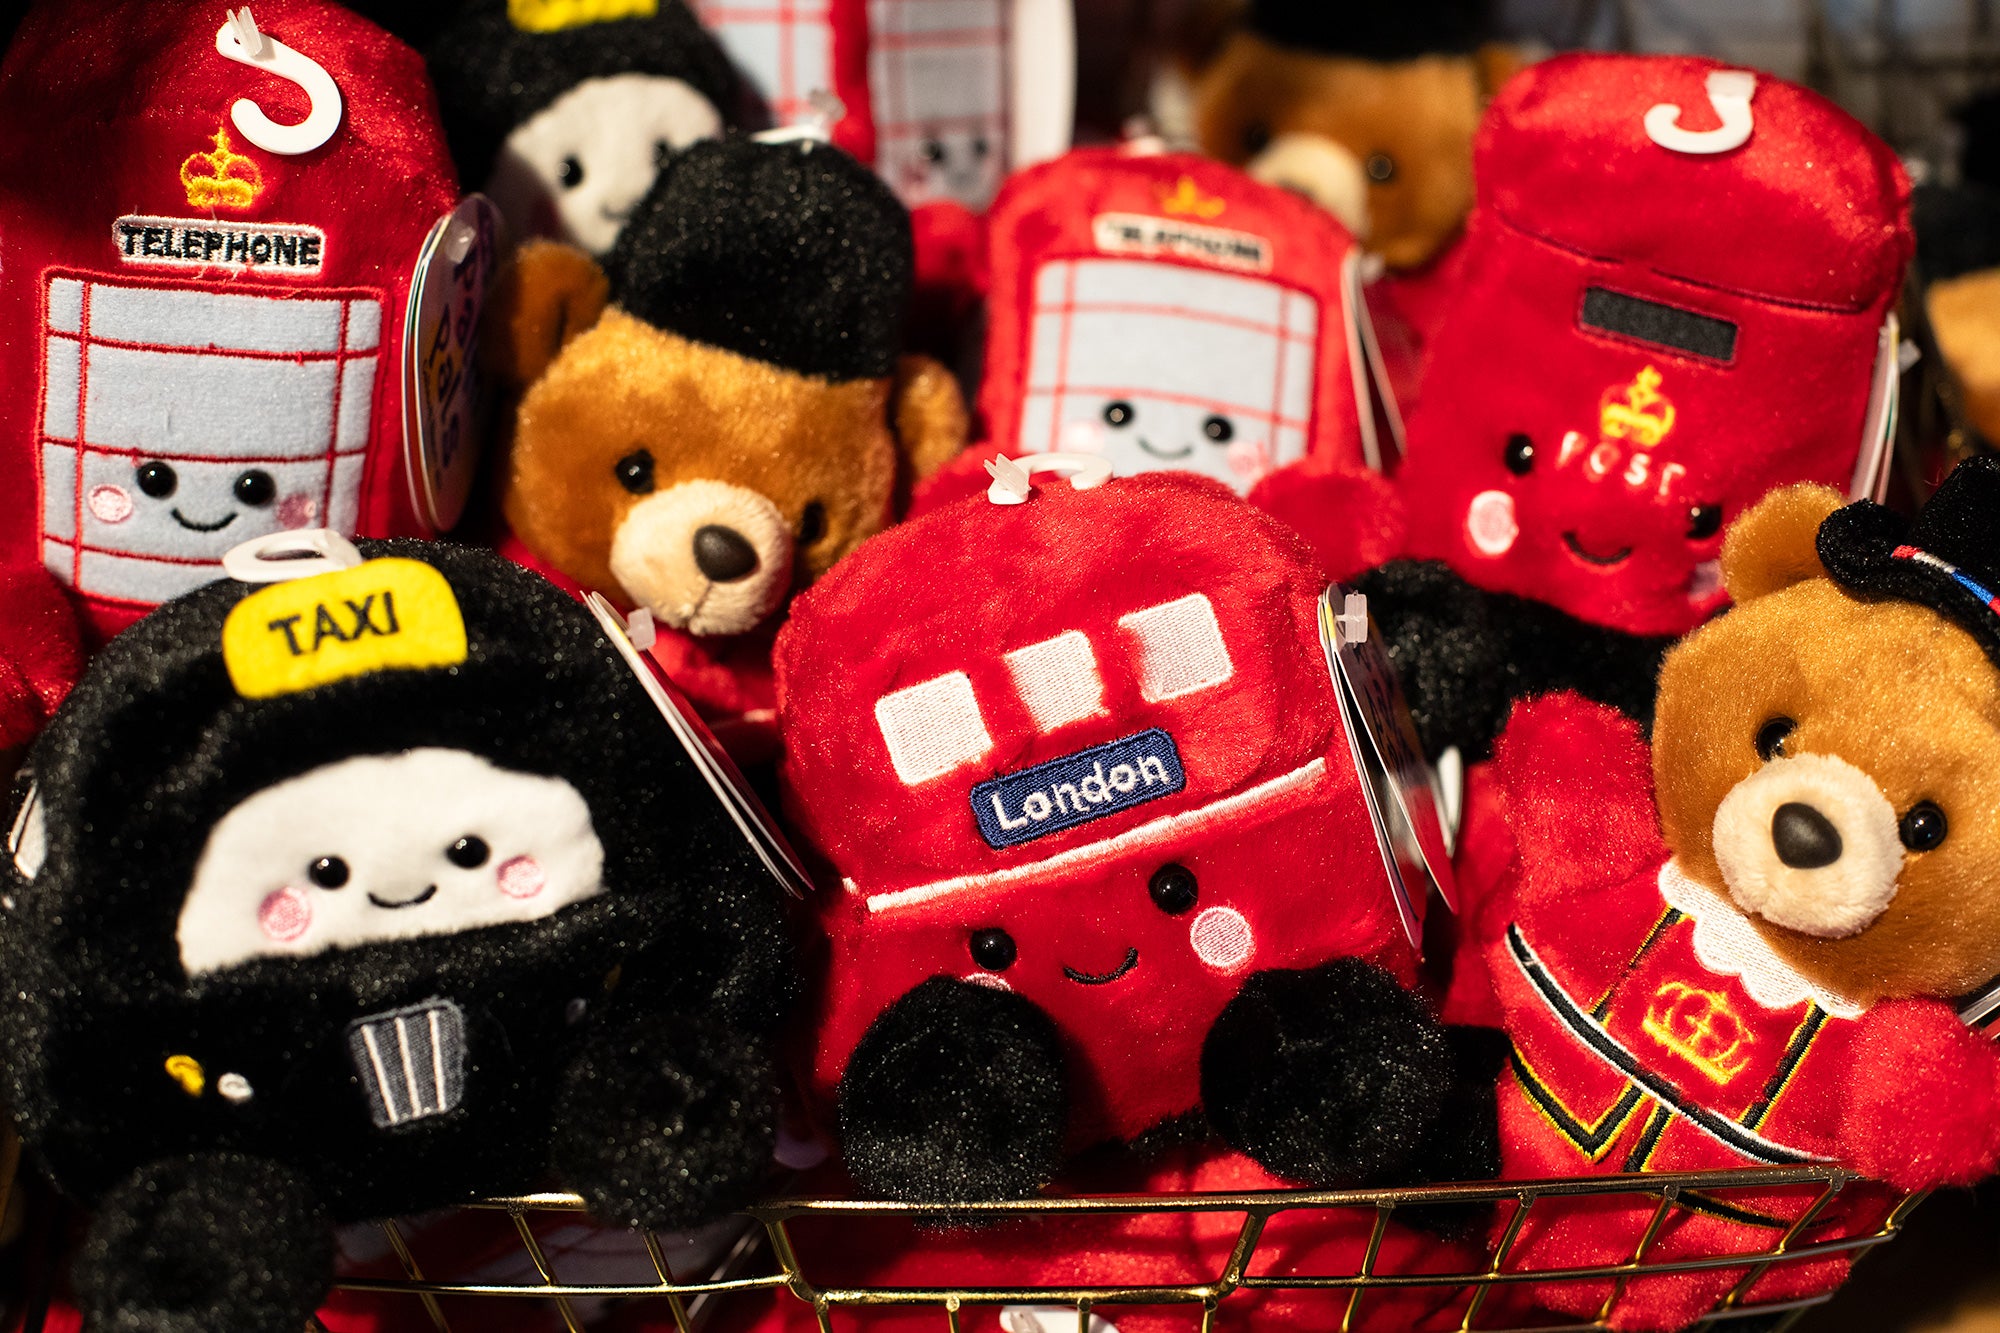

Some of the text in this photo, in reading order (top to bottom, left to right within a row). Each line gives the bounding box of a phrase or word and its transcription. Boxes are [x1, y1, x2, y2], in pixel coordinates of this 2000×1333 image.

[120, 225, 321, 265] TELEPHONE
[1556, 430, 1687, 502] POST
[268, 591, 399, 655] TAXI
[991, 756, 1170, 830] London
